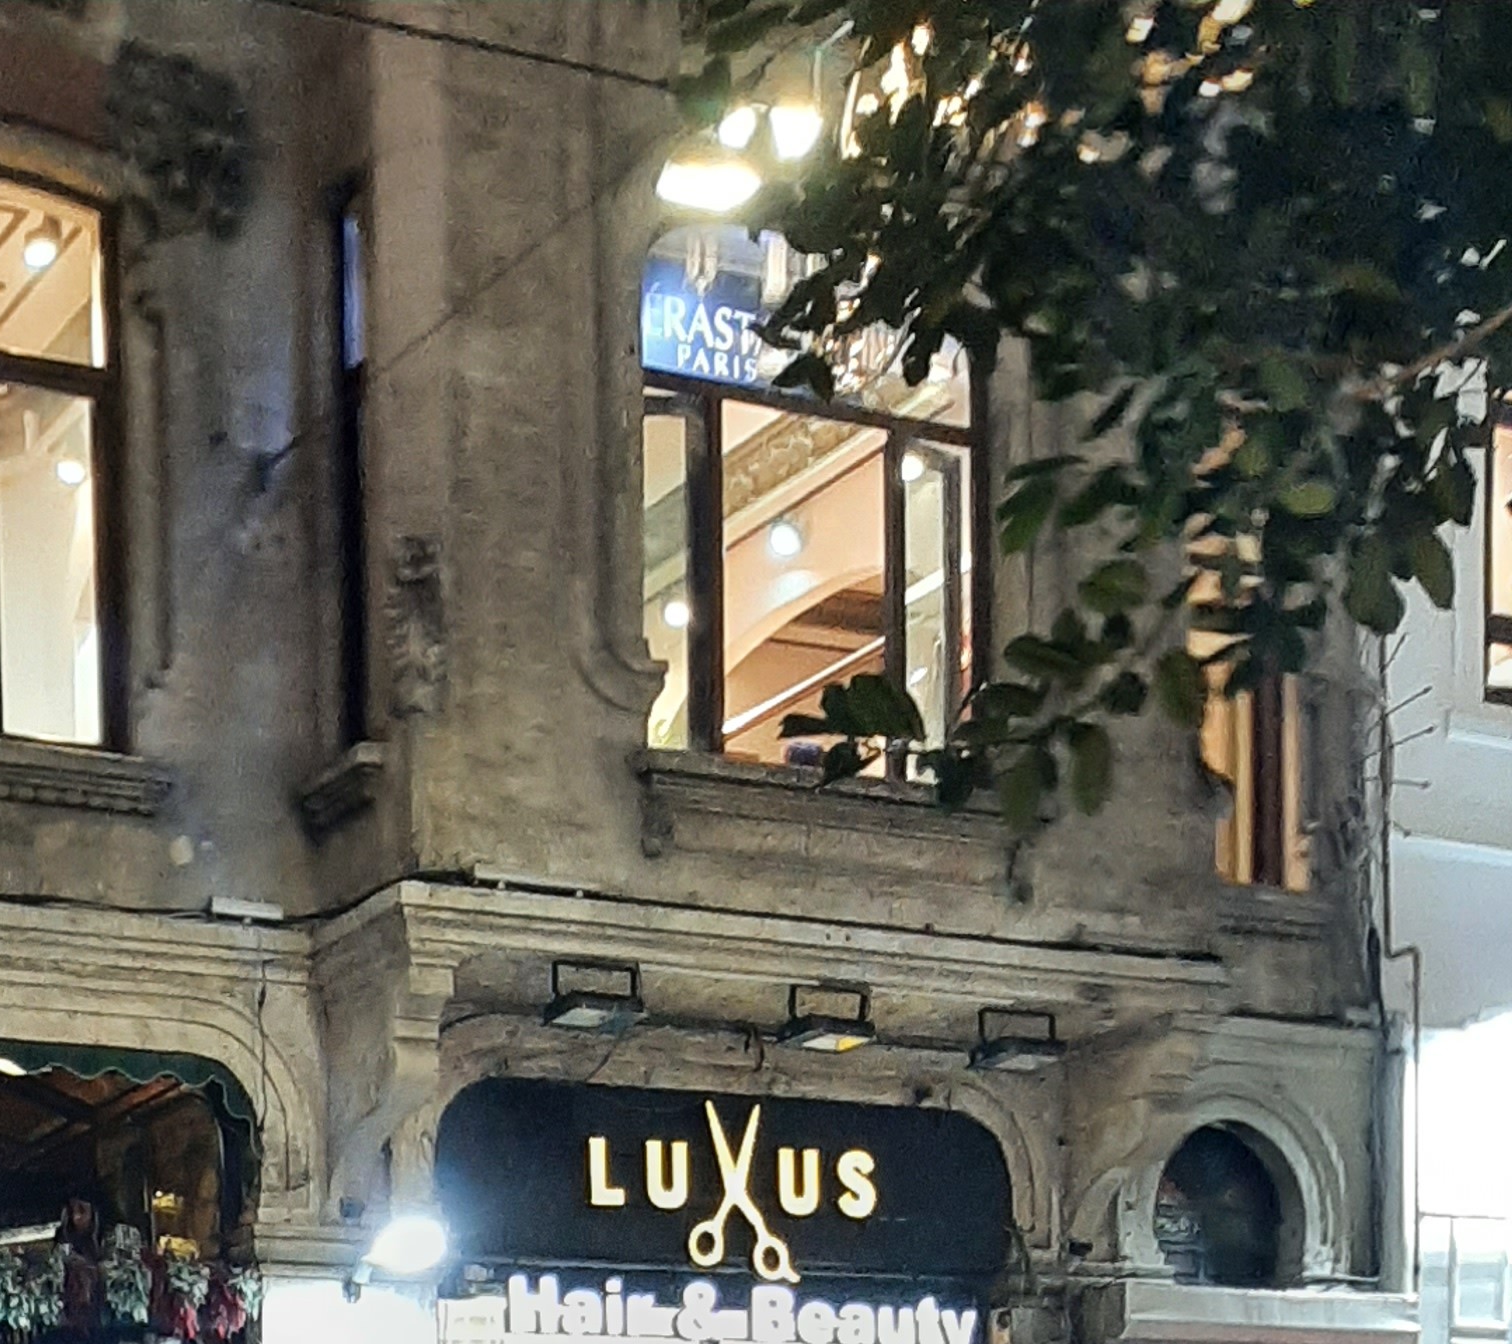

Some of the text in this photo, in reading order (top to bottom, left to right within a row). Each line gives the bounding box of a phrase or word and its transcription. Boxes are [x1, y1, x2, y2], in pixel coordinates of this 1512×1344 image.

[677, 343, 758, 381] PARIS
[507, 1274, 656, 1335] Hair
[677, 1280, 719, 1340] &
